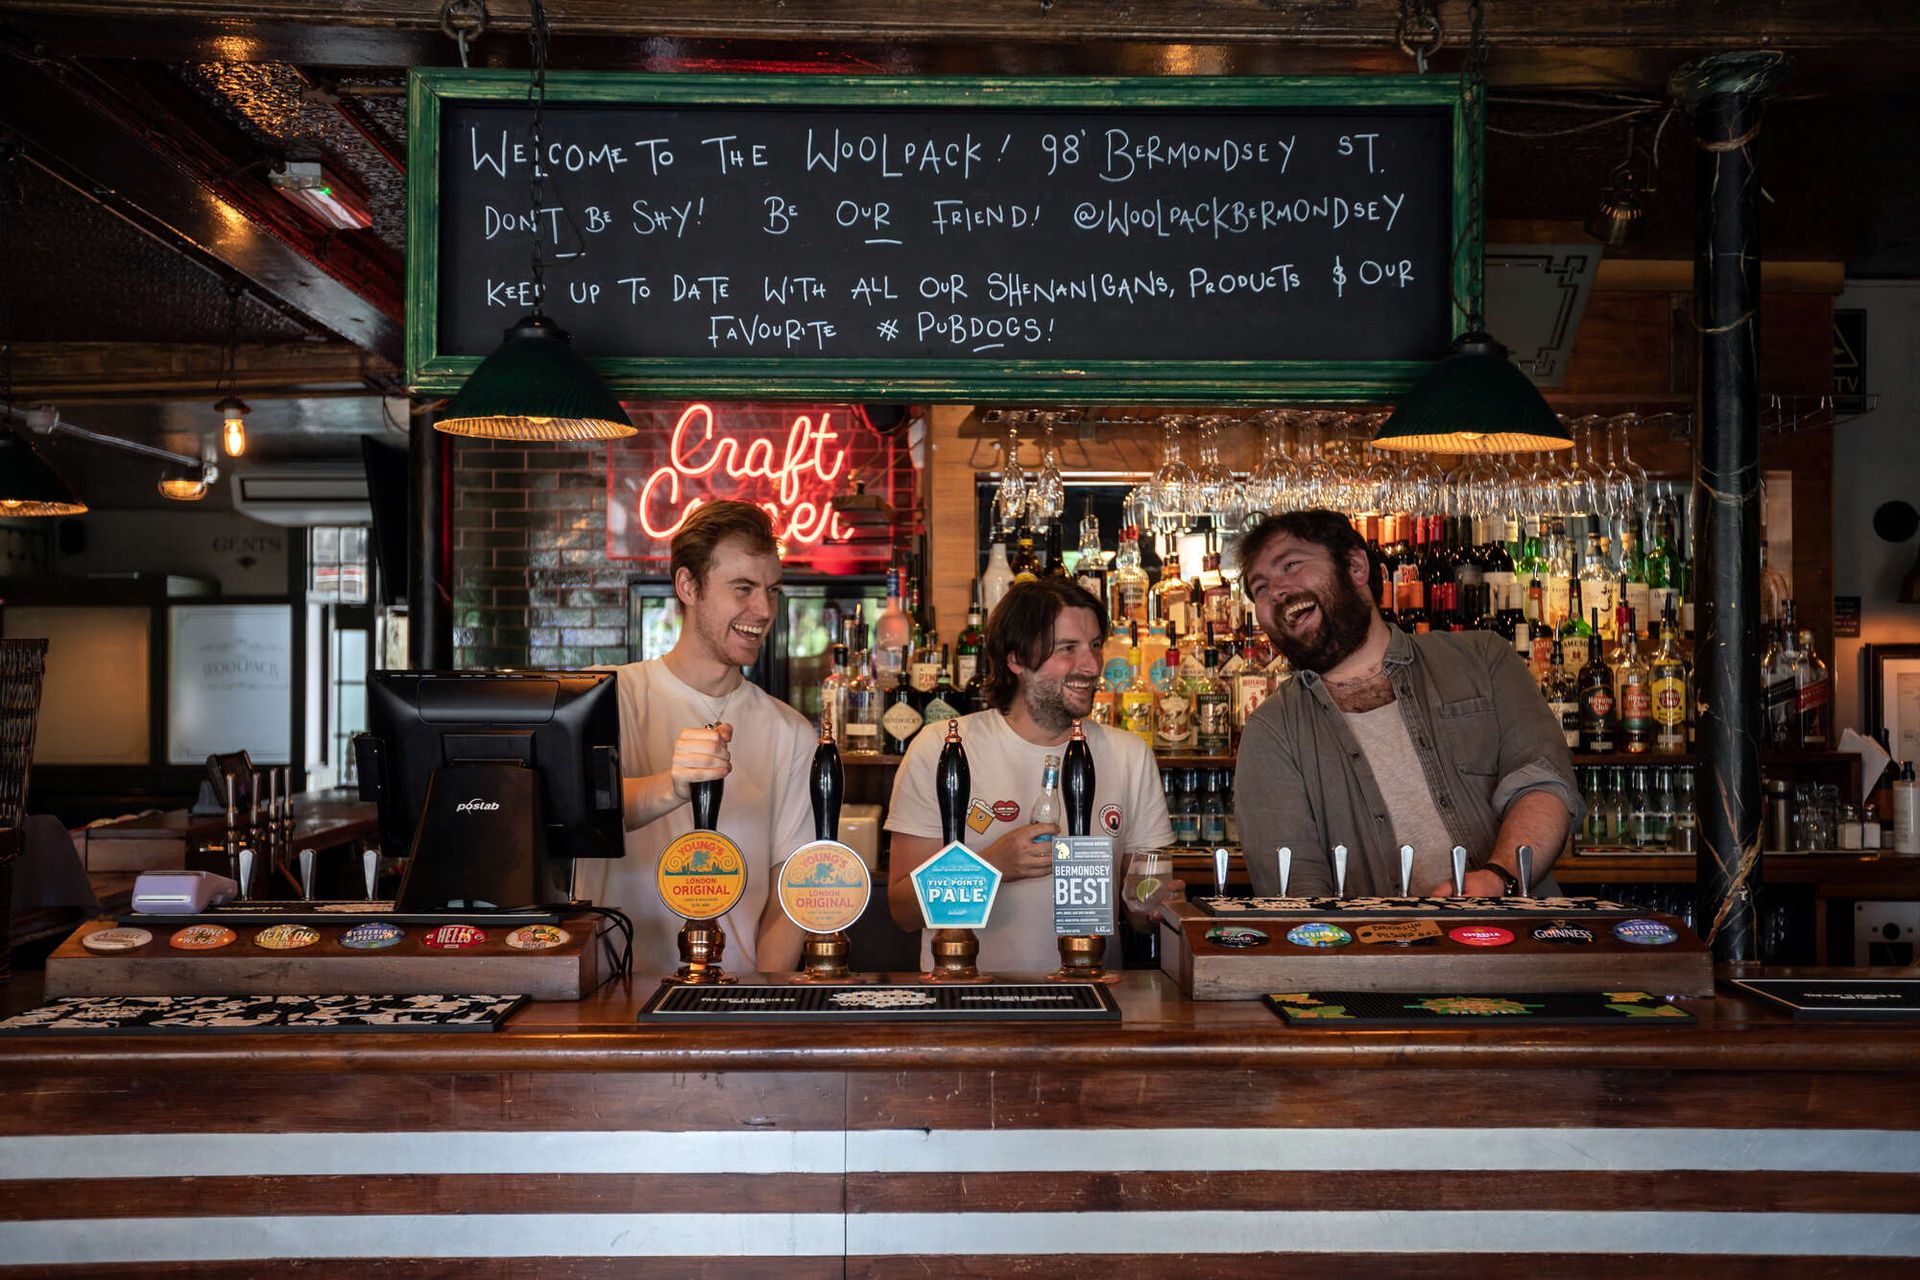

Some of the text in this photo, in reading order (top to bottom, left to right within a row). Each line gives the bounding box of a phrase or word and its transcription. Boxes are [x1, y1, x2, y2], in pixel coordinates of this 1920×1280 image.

[471, 127, 628, 178] WELCOME
[635, 138, 674, 176] TO
[701, 135, 768, 175] THE
[1099, 128, 1295, 182] BERMONDSEY
[1338, 133, 1385, 173] ST.
[584, 206, 612, 233] BE
[632, 197, 704, 238] SHY!
[763, 195, 798, 235] BE
[836, 200, 890, 226] OUR
[932, 200, 1040, 235] FRIEND!
[1073, 193, 1405, 239] @WOOLPACKBERMONDSEY
[570, 282, 600, 304] UP
[617, 277, 651, 305] TO
[672, 273, 730, 305] DATE
[764, 276, 827, 305] WITH
[850, 275, 898, 307] ALL
[919, 274, 968, 299] OUR
[987, 270, 1175, 307] SHENANIGANS,
[1189, 264, 1300, 298] PRODUCTS
[1359, 259, 1414, 288] OUR
[707, 314, 837, 350] FAVOURITE
[917, 311, 1054, 343] PUBDOGS!
[1833, 375, 1859, 393] TV
[671, 404, 844, 504] Craft
[640, 467, 855, 542] Cer
[212, 536, 282, 552] GENTS
[456, 799, 500, 814] poslab
[677, 841, 725, 857] YOUNG'S
[801, 853, 848, 869] YOUNG'S
[1055, 865, 1110, 876] BERMONDSEY
[672, 885, 730, 895] ORIGINAL
[928, 888, 984, 903] PALE
[1055, 878, 1109, 905] BEST
[796, 897, 854, 908] ORIGINAL
[1534, 928, 1592, 940] GUINNESS
